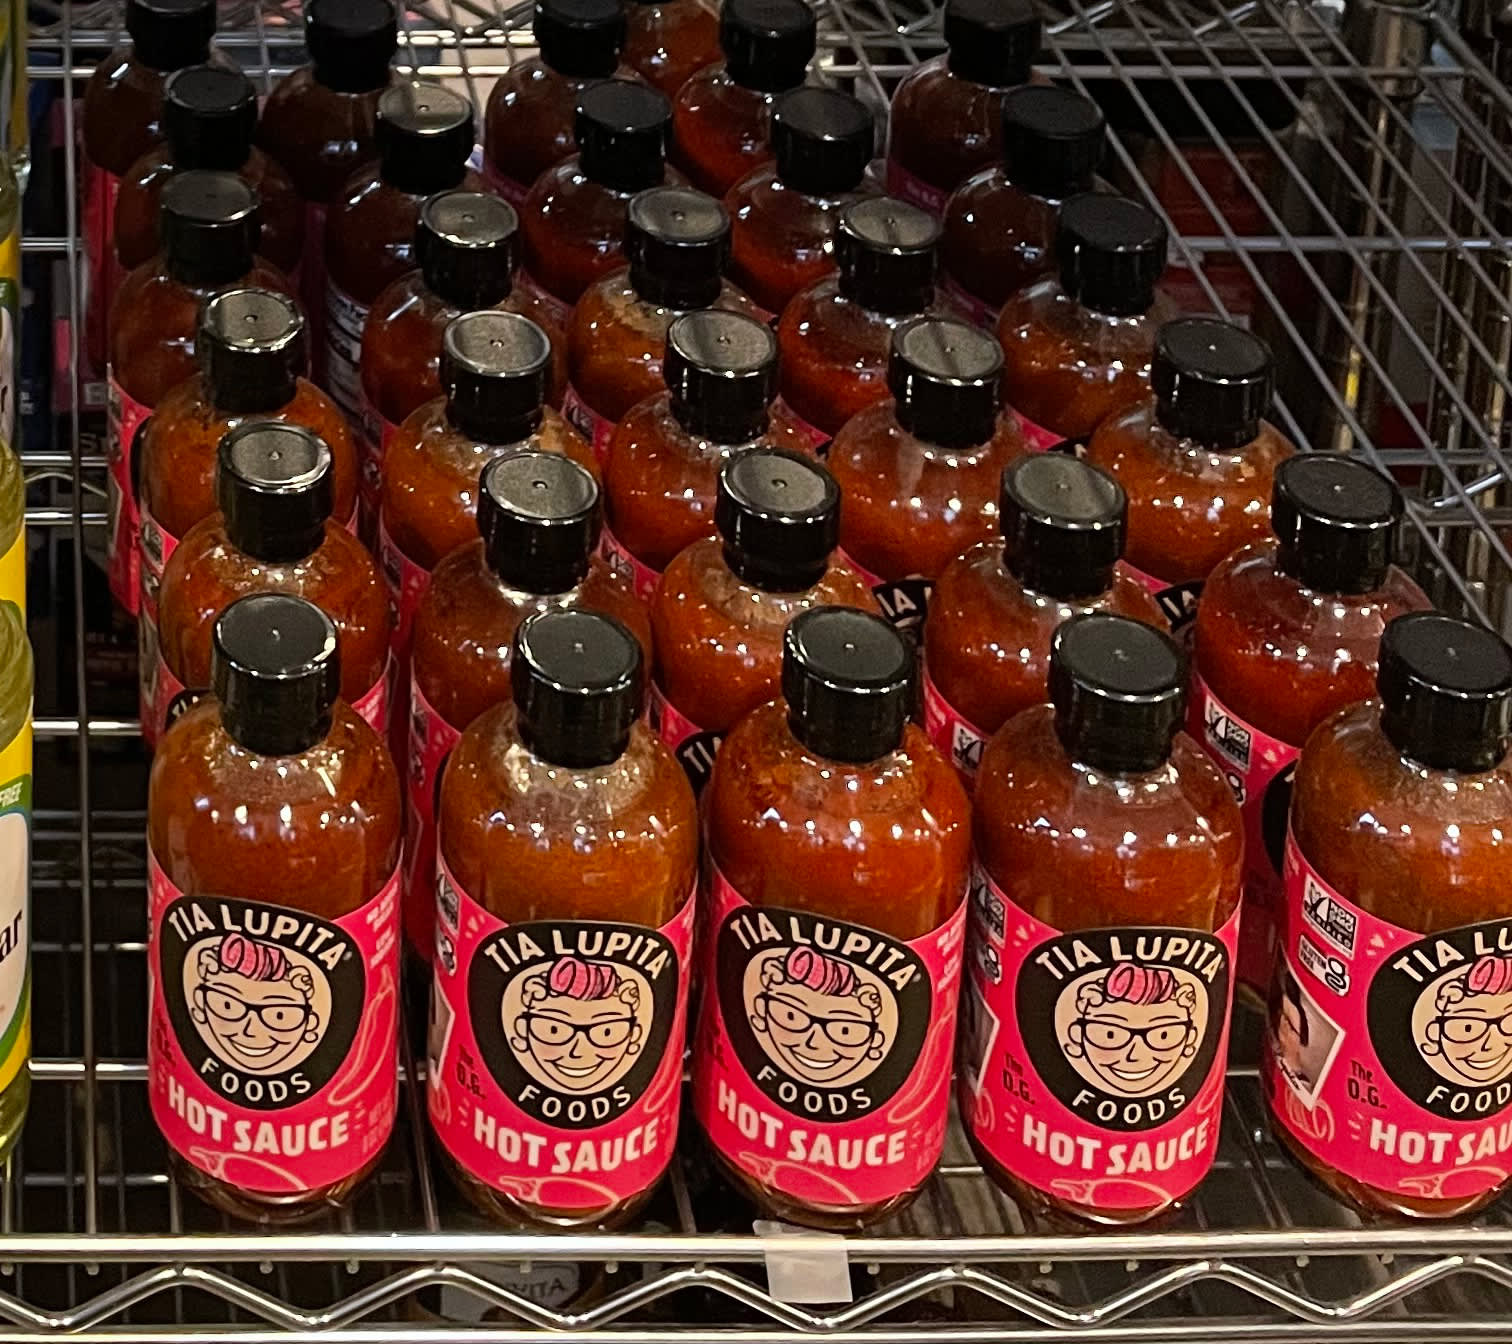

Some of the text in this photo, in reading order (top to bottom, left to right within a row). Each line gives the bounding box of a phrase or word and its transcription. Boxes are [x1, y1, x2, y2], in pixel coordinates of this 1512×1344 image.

[168, 902, 349, 971] TIA LUPITA
[484, 929, 673, 980] TIA LUPITA
[1035, 934, 1225, 983] TIA LUPITA
[1392, 939, 1465, 983] TIA
[199, 1056, 313, 1103] FOODS
[1347, 1078, 1388, 1109] O.G.
[1351, 1060, 1374, 1083] The
[168, 1077, 351, 1157] HOT SAUCE
[517, 1082, 633, 1124] FOODS
[1072, 1089, 1187, 1125] FOODS
[473, 1107, 660, 1175] HOT SAUCE
[1021, 1113, 1210, 1176] HOT SAUCE
[1368, 1117, 1453, 1165] HOT
